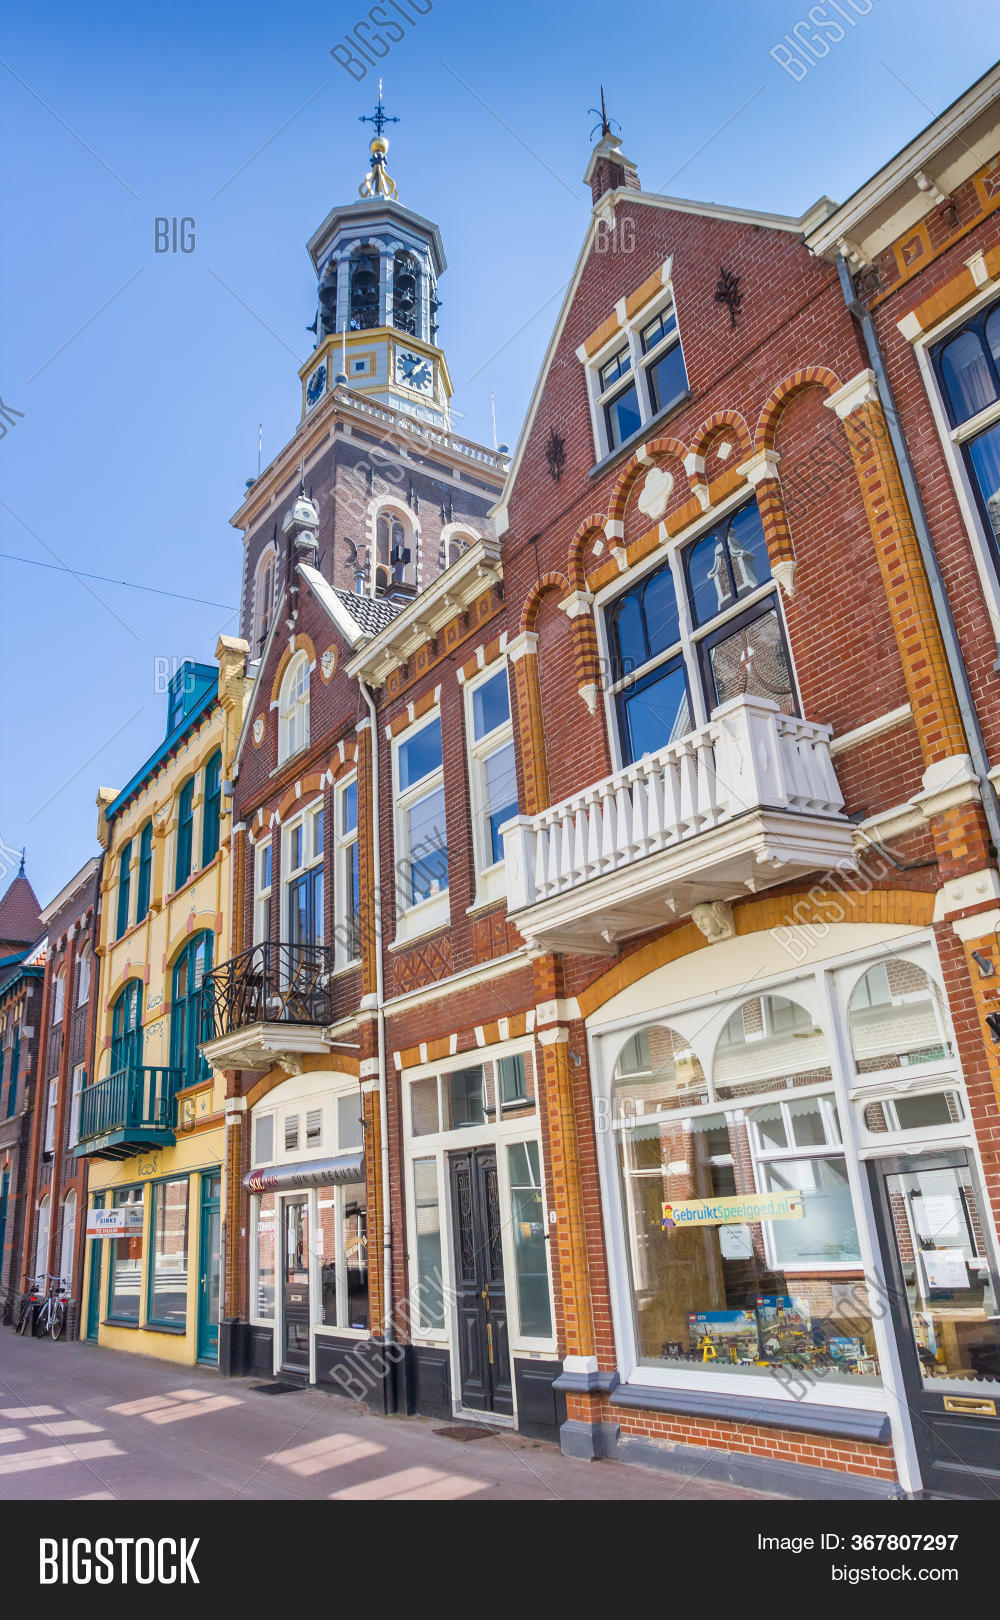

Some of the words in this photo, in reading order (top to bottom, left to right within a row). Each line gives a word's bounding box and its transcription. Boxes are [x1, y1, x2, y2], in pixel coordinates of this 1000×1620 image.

[291, 1174, 309, 1185] SUN
[321, 1167, 360, 1182] BEAUTY
[673, 1200, 790, 1223] GebruiktSpeelgoed.nl
